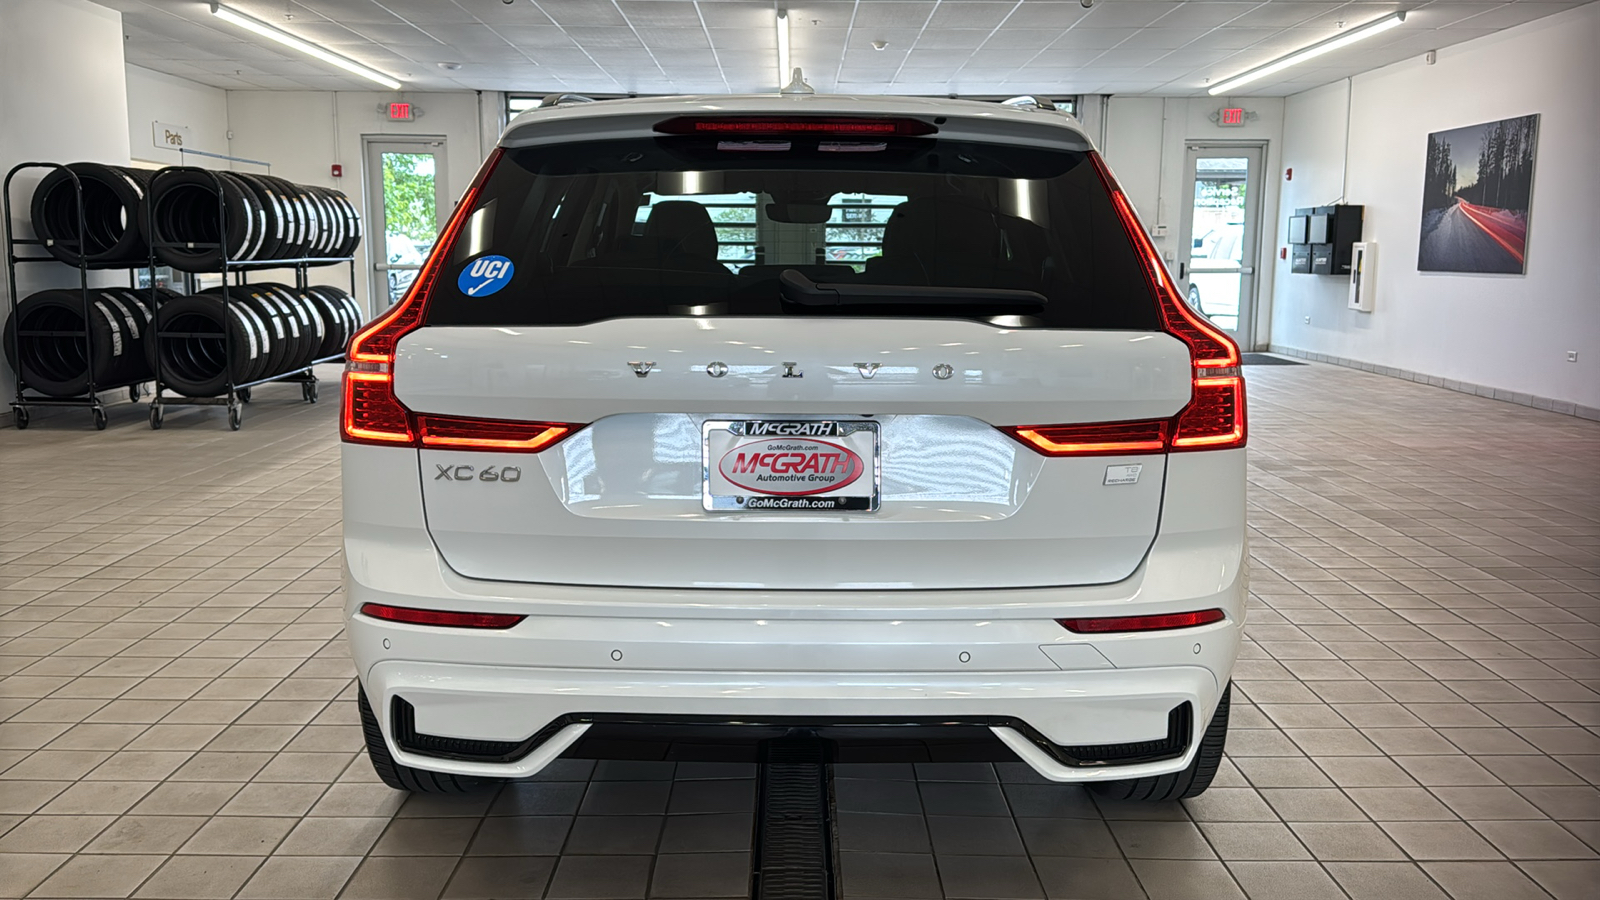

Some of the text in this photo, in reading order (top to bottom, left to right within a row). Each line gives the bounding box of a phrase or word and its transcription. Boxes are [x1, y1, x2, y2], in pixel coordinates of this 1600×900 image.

[390, 103, 409, 119] EXIT
[1223, 108, 1243, 124] EXIT
[165, 129, 183, 146] Parts
[470, 259, 511, 279] UCI
[627, 361, 955, 380] VOLVO
[756, 474, 835, 483] Automotive Group
[748, 498, 835, 508] GoMcGrath.com
